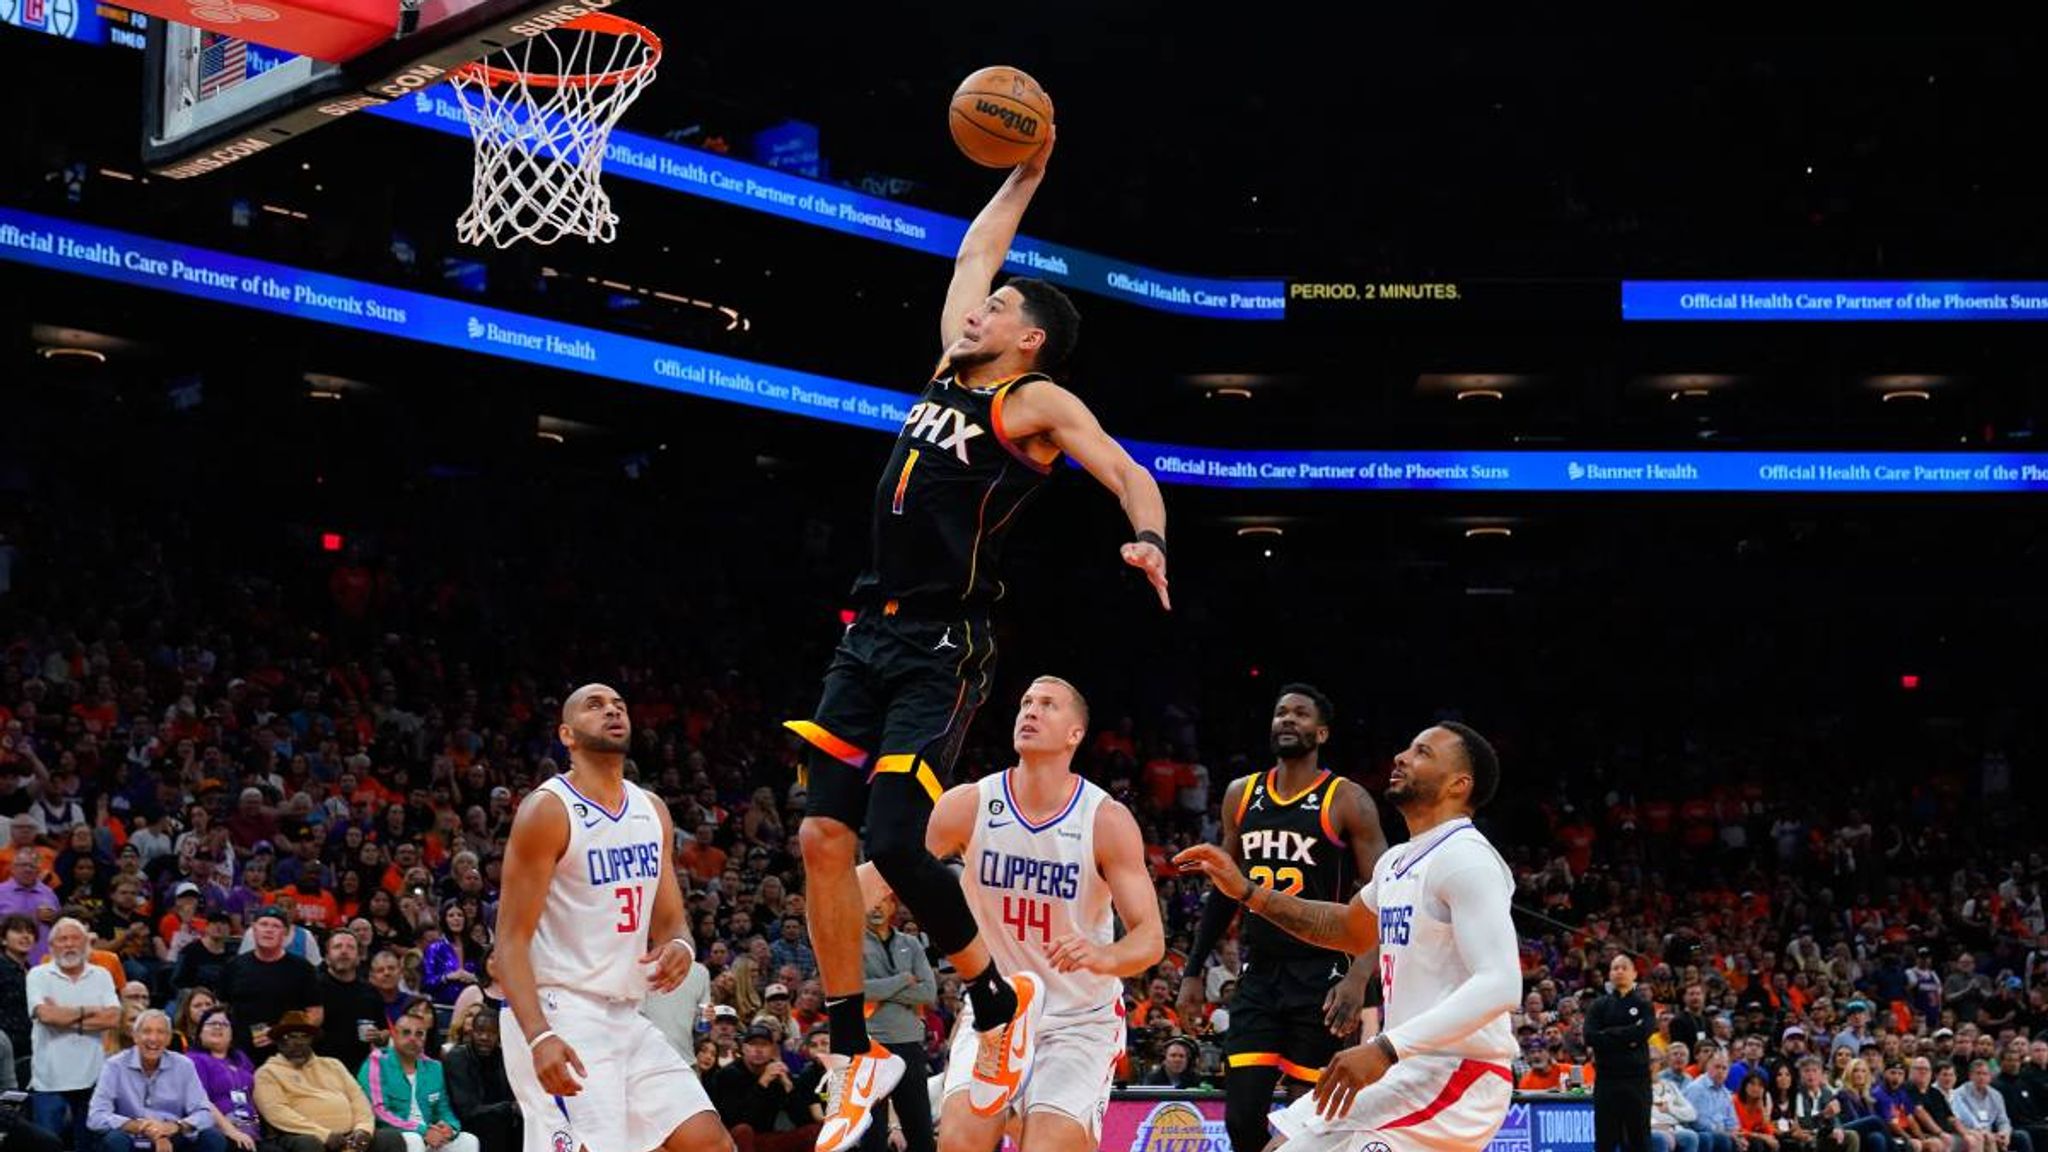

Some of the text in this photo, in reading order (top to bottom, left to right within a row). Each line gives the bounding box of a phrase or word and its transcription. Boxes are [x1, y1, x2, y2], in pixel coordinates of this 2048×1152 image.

[976, 100, 1037, 136] Wilson
[603, 143, 927, 240] Official Health Care Partner of the Phoenix Suns
[58, 236, 121, 268] Health
[125, 252, 169, 275] Care
[172, 260, 237, 290] Partner
[241, 275, 263, 294] of
[263, 280, 291, 301] the
[294, 285, 362, 315] Phoenix
[365, 300, 407, 324] Suns
[1028, 251, 1068, 275] Health
[1107, 272, 1150, 296] Official
[1151, 283, 1191, 306] Health
[1193, 294, 1228, 309] Care
[1290, 284, 1462, 300] PERIOD, 2 MINUTES.
[1680, 293, 2048, 309] Official Health Care Partner of the Phoenix Suns
[486, 323, 597, 361] Banner Health
[653, 358, 706, 384] Official
[708, 369, 755, 394] Health
[757, 380, 790, 400] Care
[791, 386, 841, 410] Partner
[842, 395, 858, 413] of
[858, 398, 880, 417] the
[904, 402, 984, 465] PHX
[893, 448, 919, 514] 1
[1154, 456, 1509, 479] Official Health Care Partner of the Phoenix Suns
[1587, 463, 1698, 480] Banner Health
[1759, 465, 1816, 481] Official
[1819, 465, 1871, 480] Health
[1874, 466, 1912, 480] Care
[1914, 466, 1971, 481] Partner
[1974, 465, 1993, 480] of
[1993, 465, 2018, 480] the
[587, 842, 660, 885] CLIPPERS
[1241, 830, 1318, 866] PHX
[980, 850, 1079, 900] CLIPPERS
[1003, 896, 1051, 944] 44
